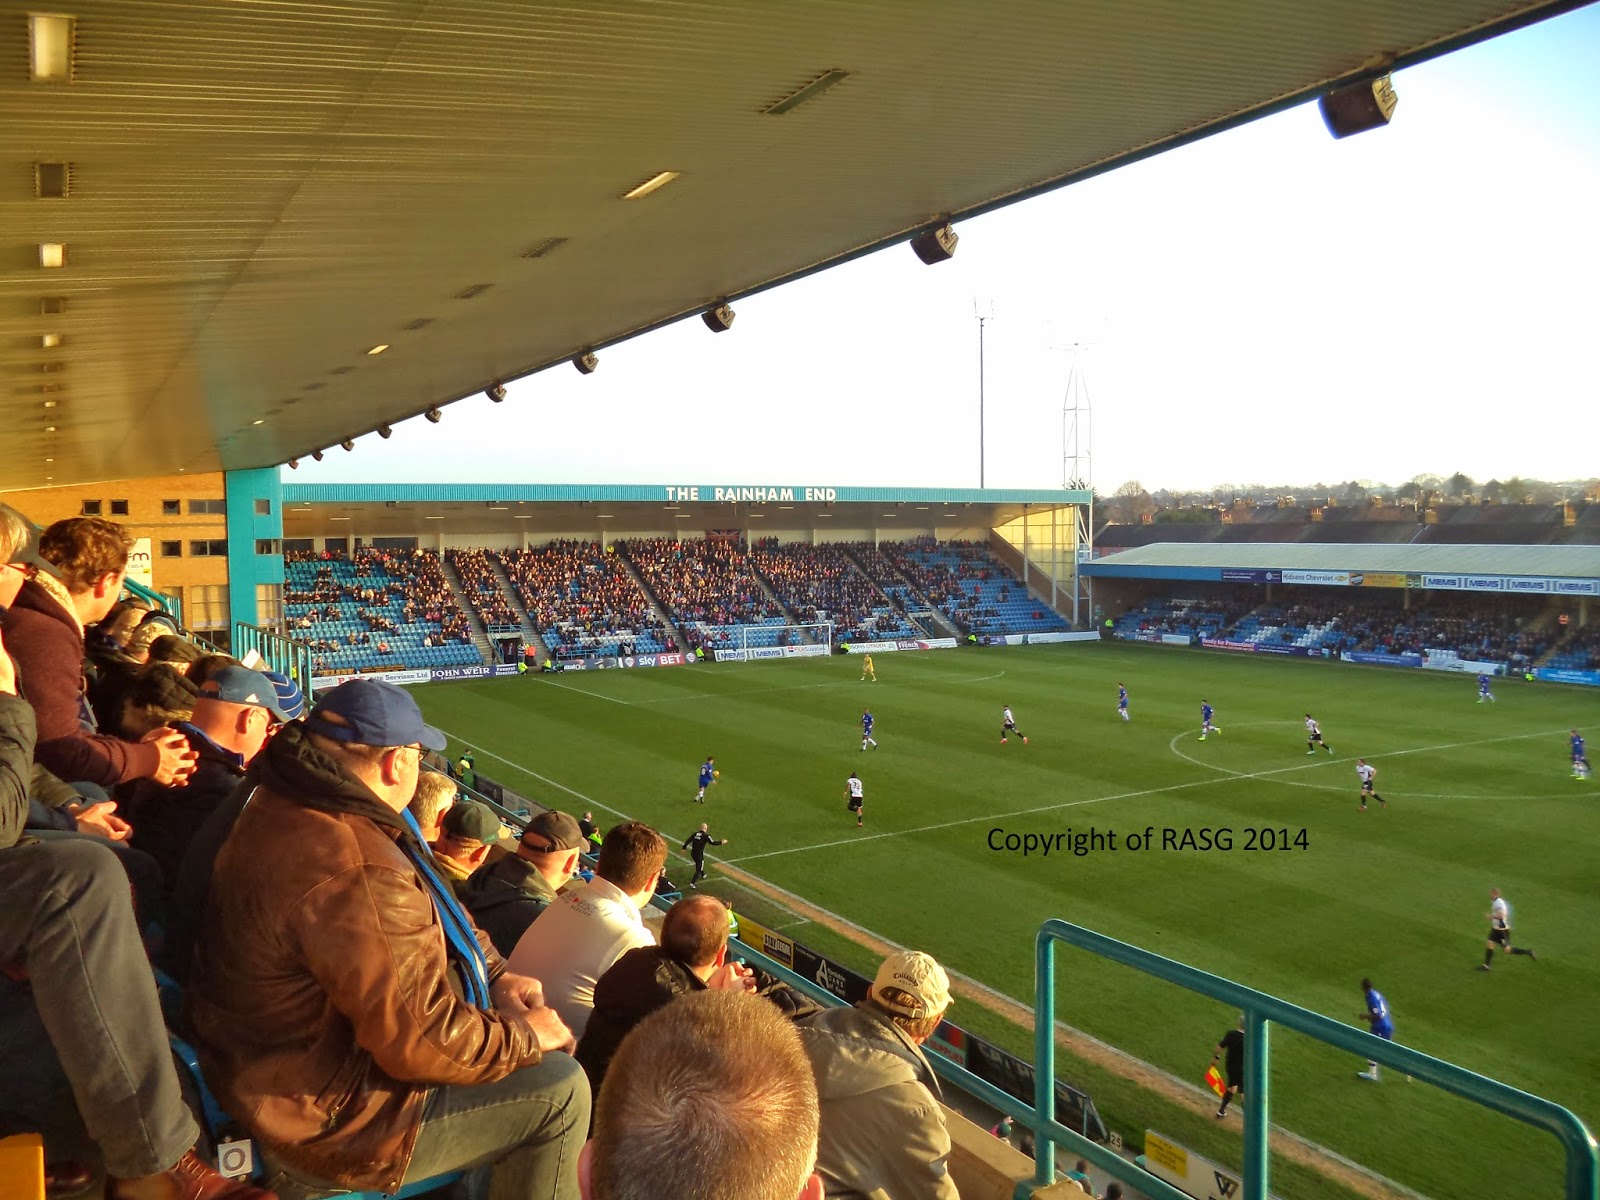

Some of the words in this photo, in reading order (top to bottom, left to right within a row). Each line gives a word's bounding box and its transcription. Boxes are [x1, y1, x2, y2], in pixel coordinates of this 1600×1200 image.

[666, 487, 698, 500] THE
[715, 488, 794, 501] RAINHAM
[805, 488, 836, 501] END
[1306, 574, 1333, 582] Chevrolet
[1427, 578, 1457, 586] MEMS
[1468, 580, 1499, 588] MEMS
[1511, 581, 1544, 589] MEMS
[1558, 582, 1592, 591] MEMS
[756, 649, 781, 657] MEMS
[639, 656, 656, 667] sky
[660, 654, 681, 665] BET
[432, 669, 459, 678] JOHN
[462, 667, 490, 675] WEIR
[764, 934, 777, 951] STAY
[893, 972, 918, 987] Callaway
[1111, 1134, 1121, 1148] 25
